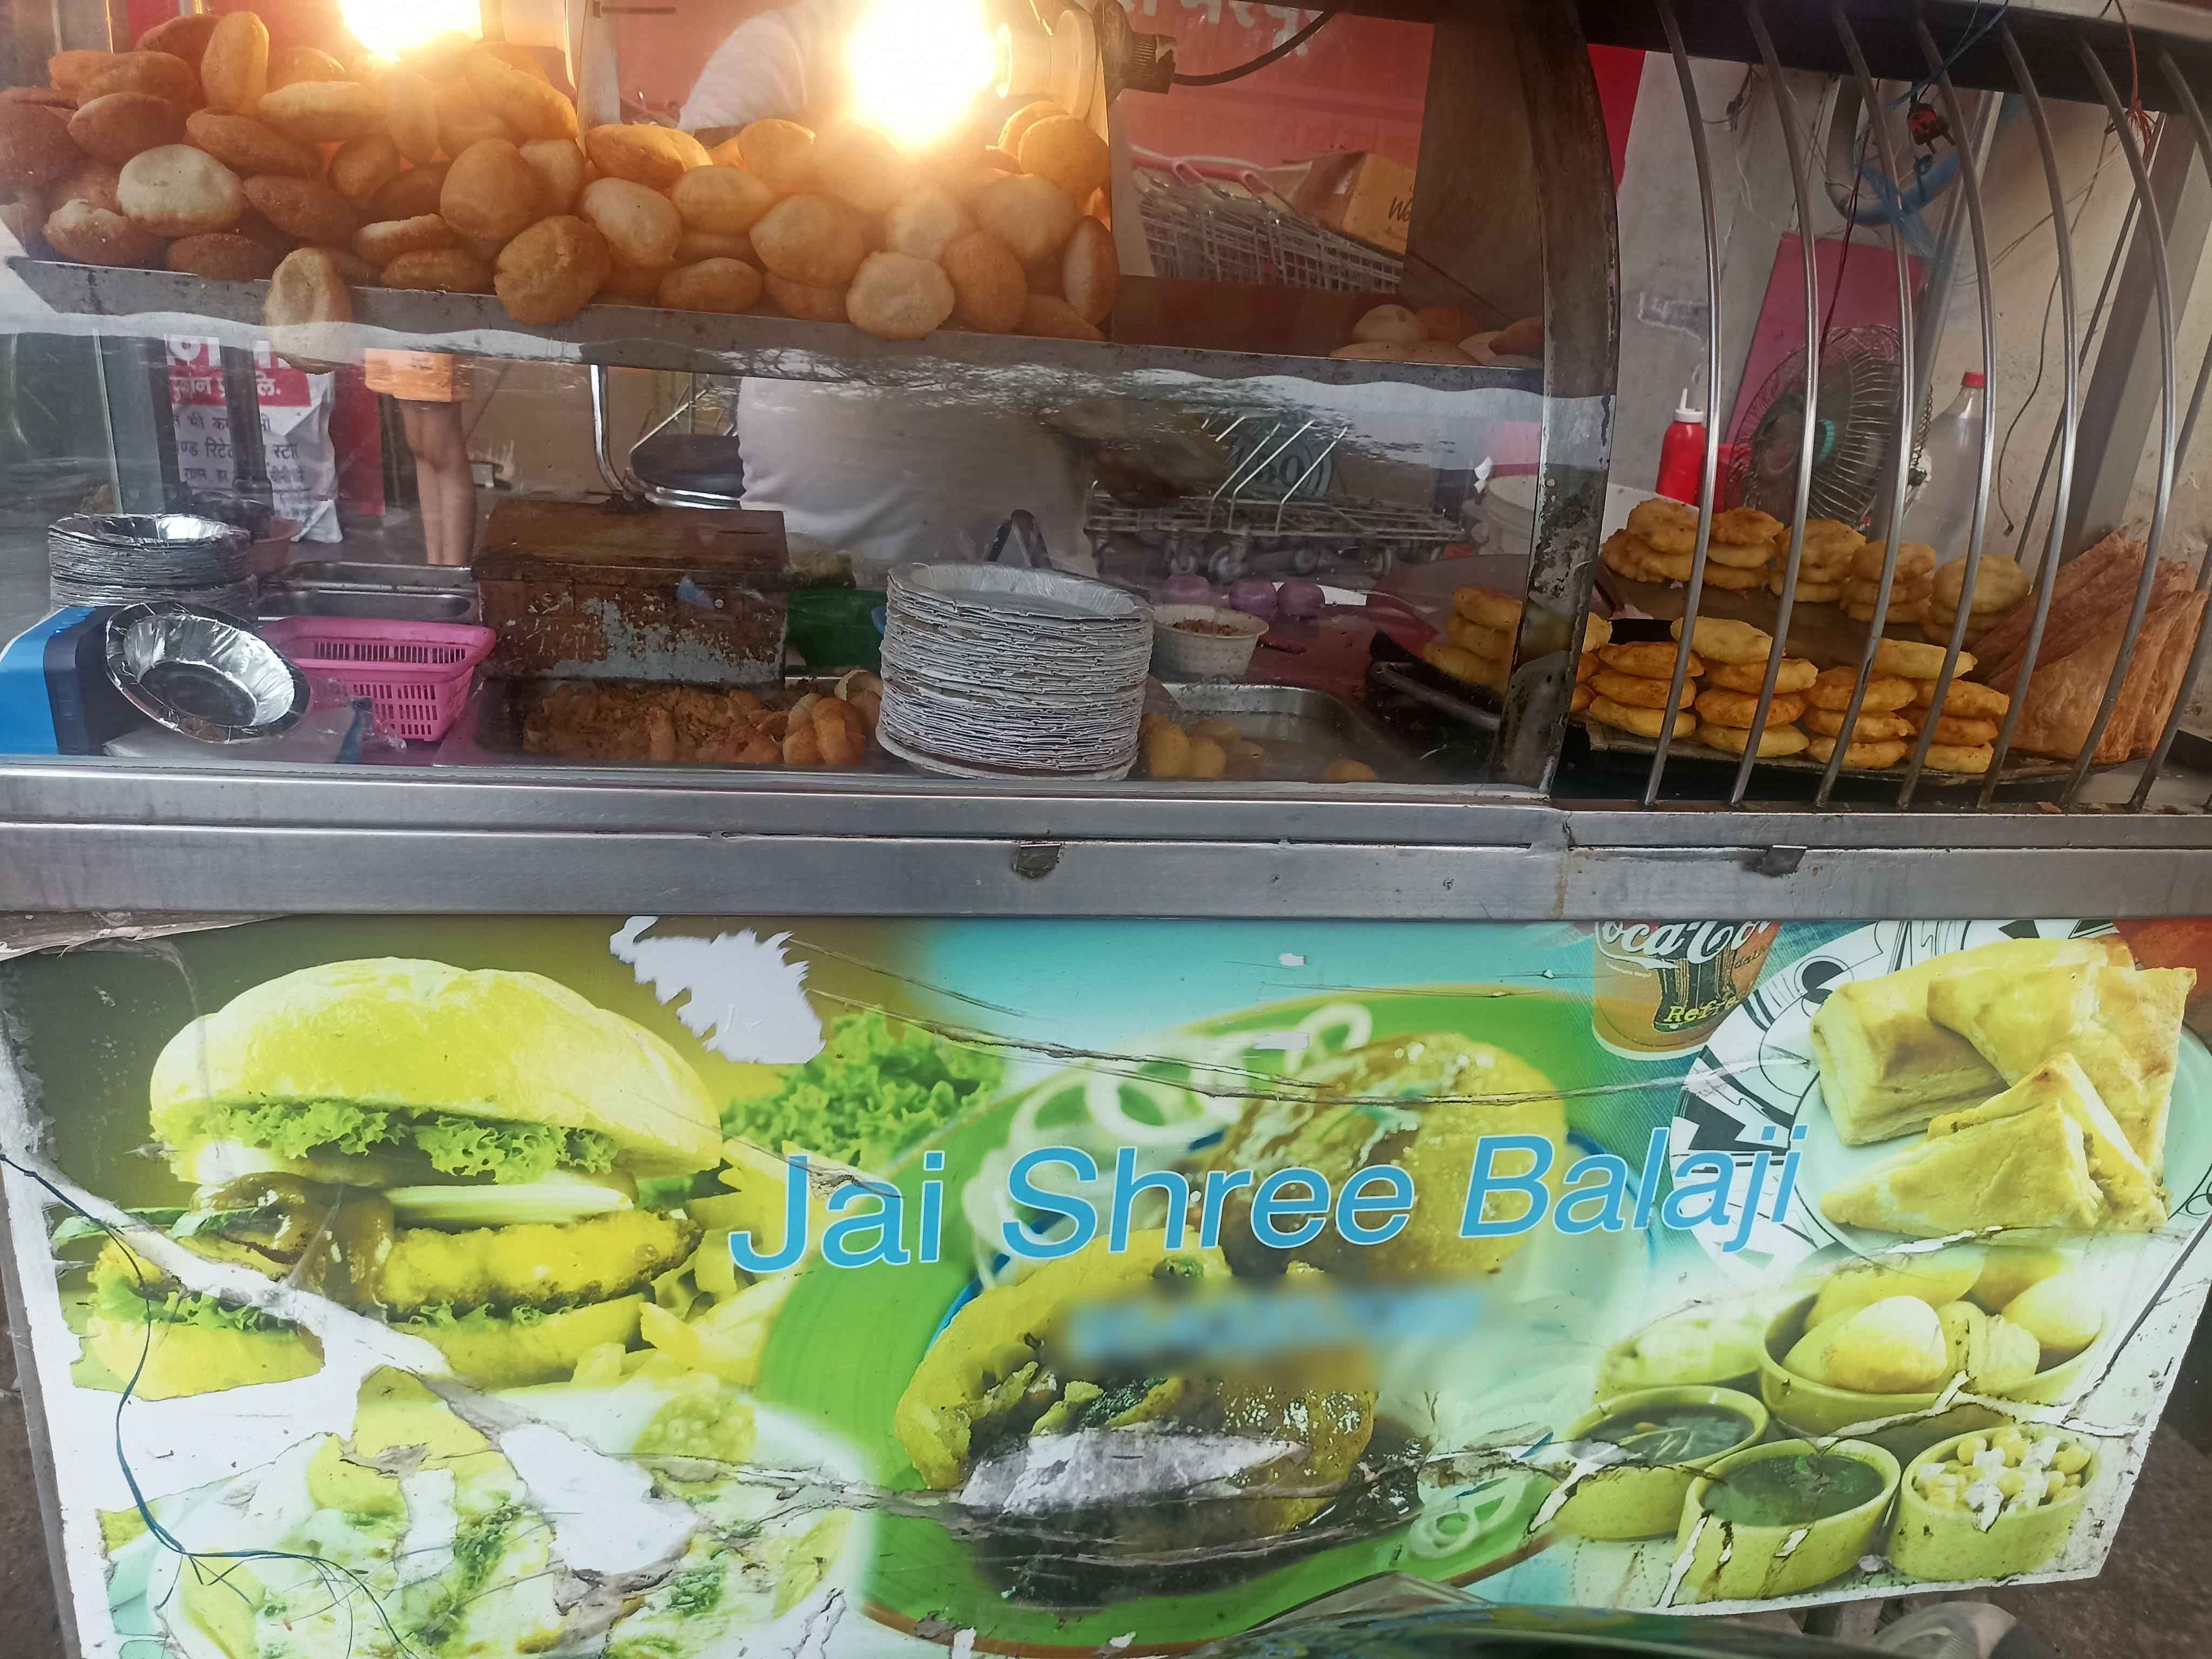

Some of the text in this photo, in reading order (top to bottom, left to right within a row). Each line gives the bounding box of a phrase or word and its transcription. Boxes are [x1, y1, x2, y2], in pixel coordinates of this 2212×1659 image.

[728, 1124, 1810, 1273] Jai Shree Balaji
